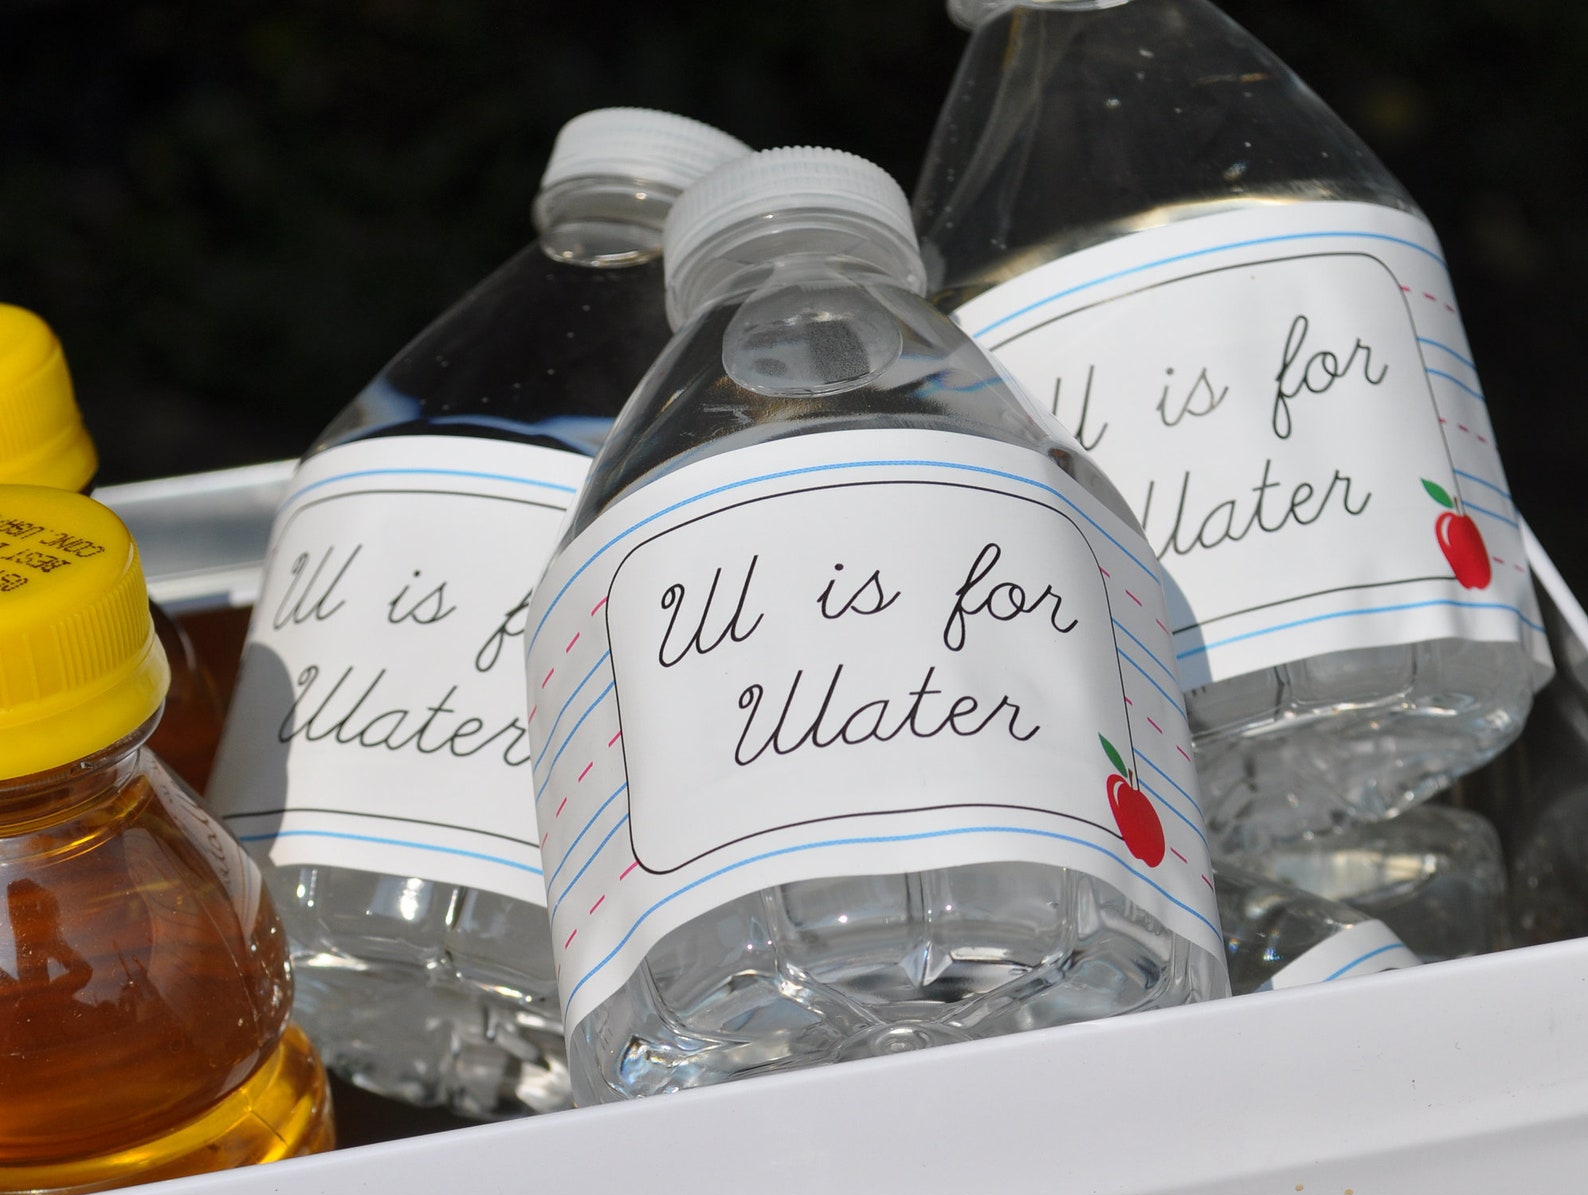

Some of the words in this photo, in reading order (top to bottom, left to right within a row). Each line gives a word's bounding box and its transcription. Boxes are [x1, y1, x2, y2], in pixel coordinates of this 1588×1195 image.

[1156, 368, 1229, 427] is
[1272, 315, 1388, 440] for
[387, 570, 457, 625] is
[817, 563, 901, 619] is
[943, 543, 1078, 652] for
[734, 664, 1040, 766] Water
